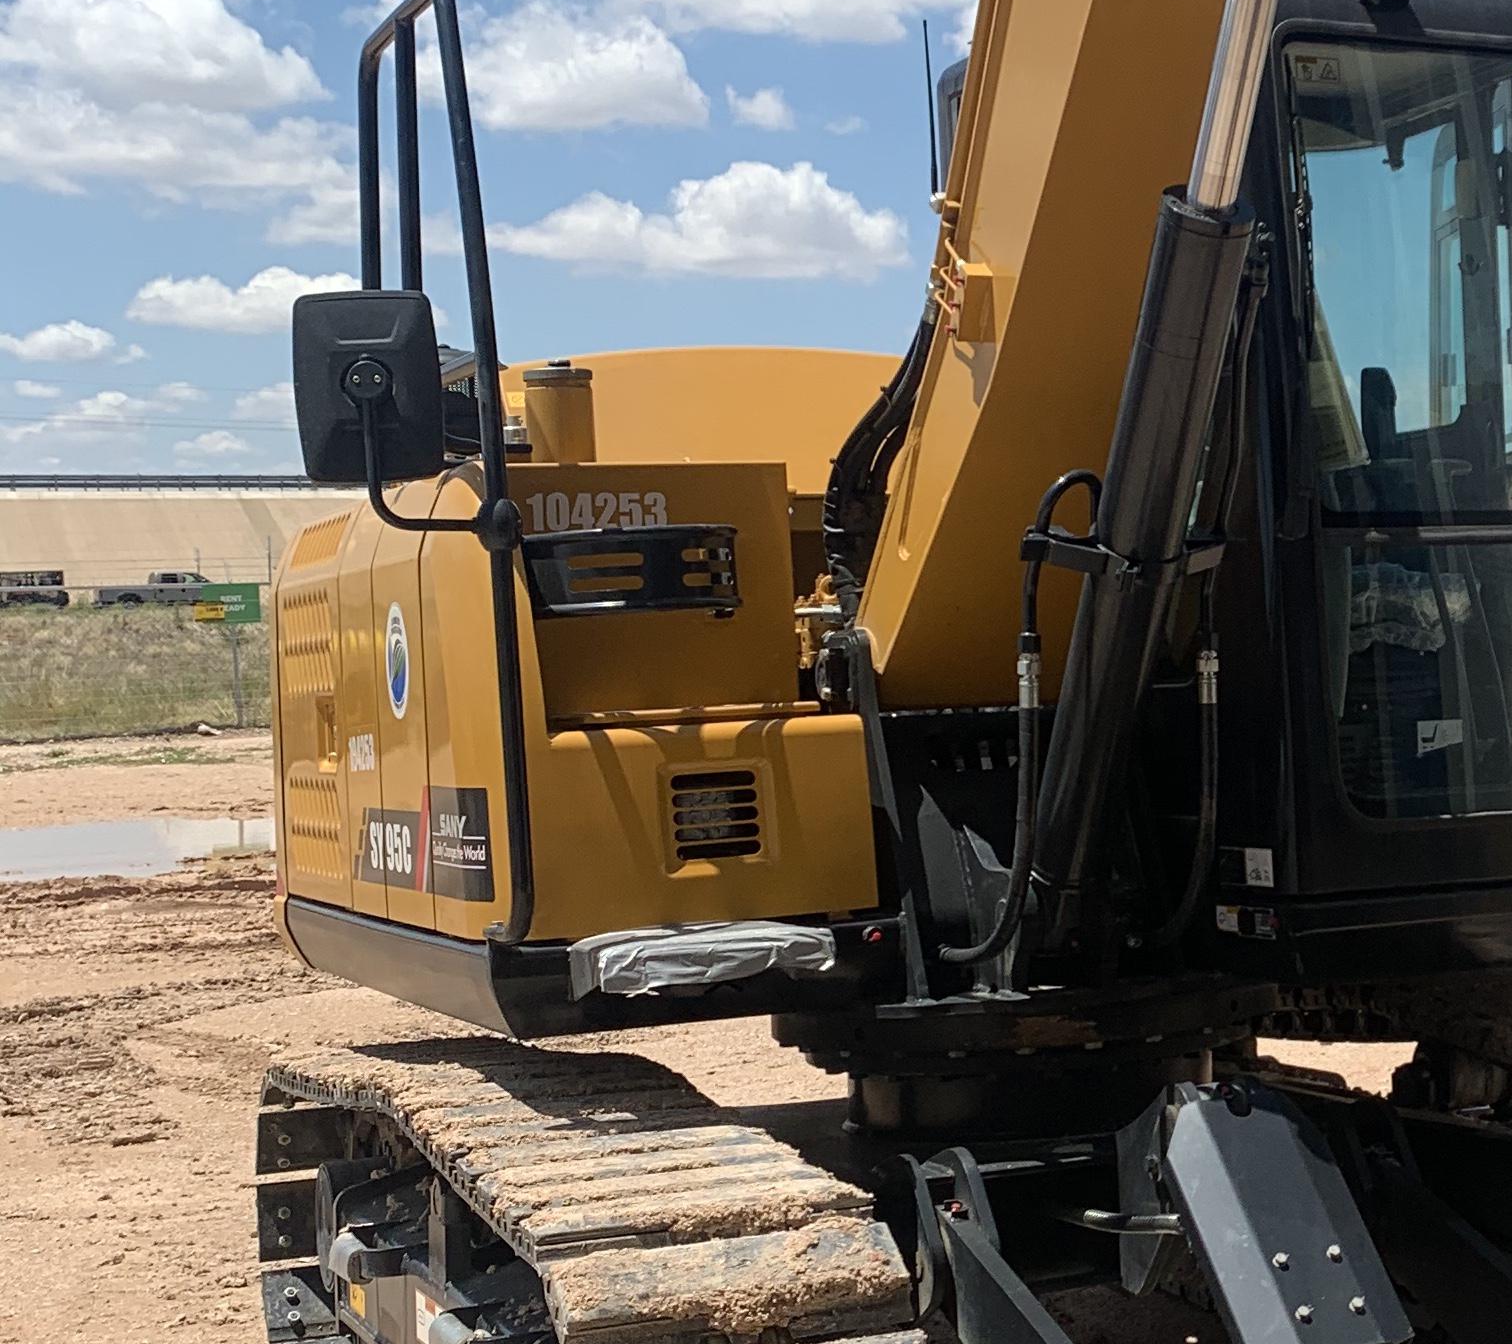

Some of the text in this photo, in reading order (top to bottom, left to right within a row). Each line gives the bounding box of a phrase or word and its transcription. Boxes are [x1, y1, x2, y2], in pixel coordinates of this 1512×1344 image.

[526, 491, 668, 532] 104253
[440, 813, 467, 838] SANY
[463, 844, 486, 862] World
